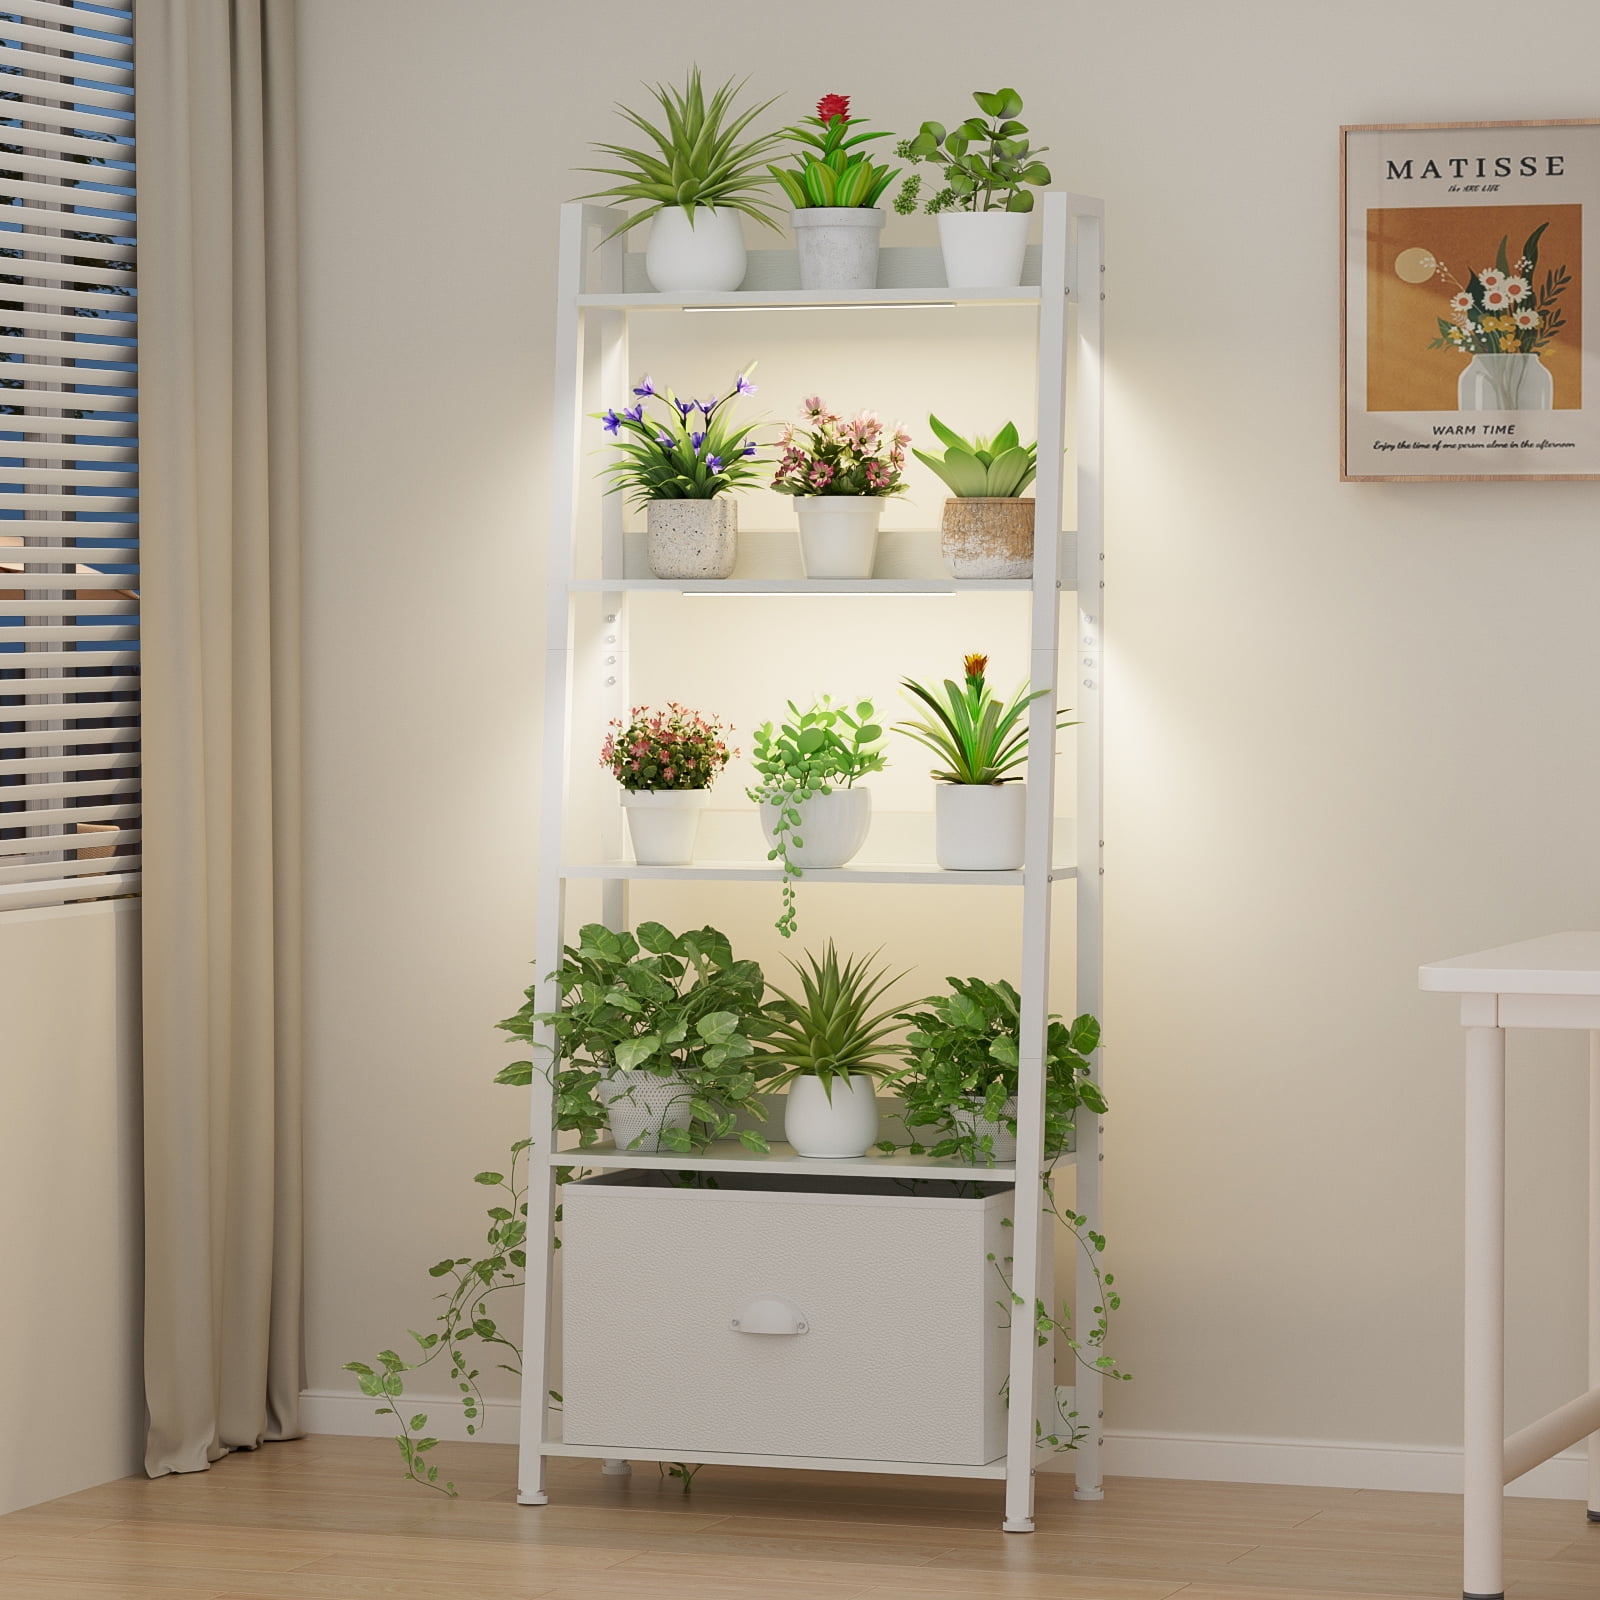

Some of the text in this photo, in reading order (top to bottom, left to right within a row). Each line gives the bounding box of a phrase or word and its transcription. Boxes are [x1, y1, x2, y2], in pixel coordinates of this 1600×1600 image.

[1386, 156, 1565, 179] MATISSE
[1432, 424, 1515, 435] WARM TIME
[1373, 440, 1395, 451] Enjoy
[1396, 440, 1411, 449] the
[1412, 441, 1430, 449] time
[1431, 440, 1442, 451] of
[1486, 440, 1508, 448] alone
[1520, 440, 1534, 448] the
[1535, 439, 1575, 450] afternoon
